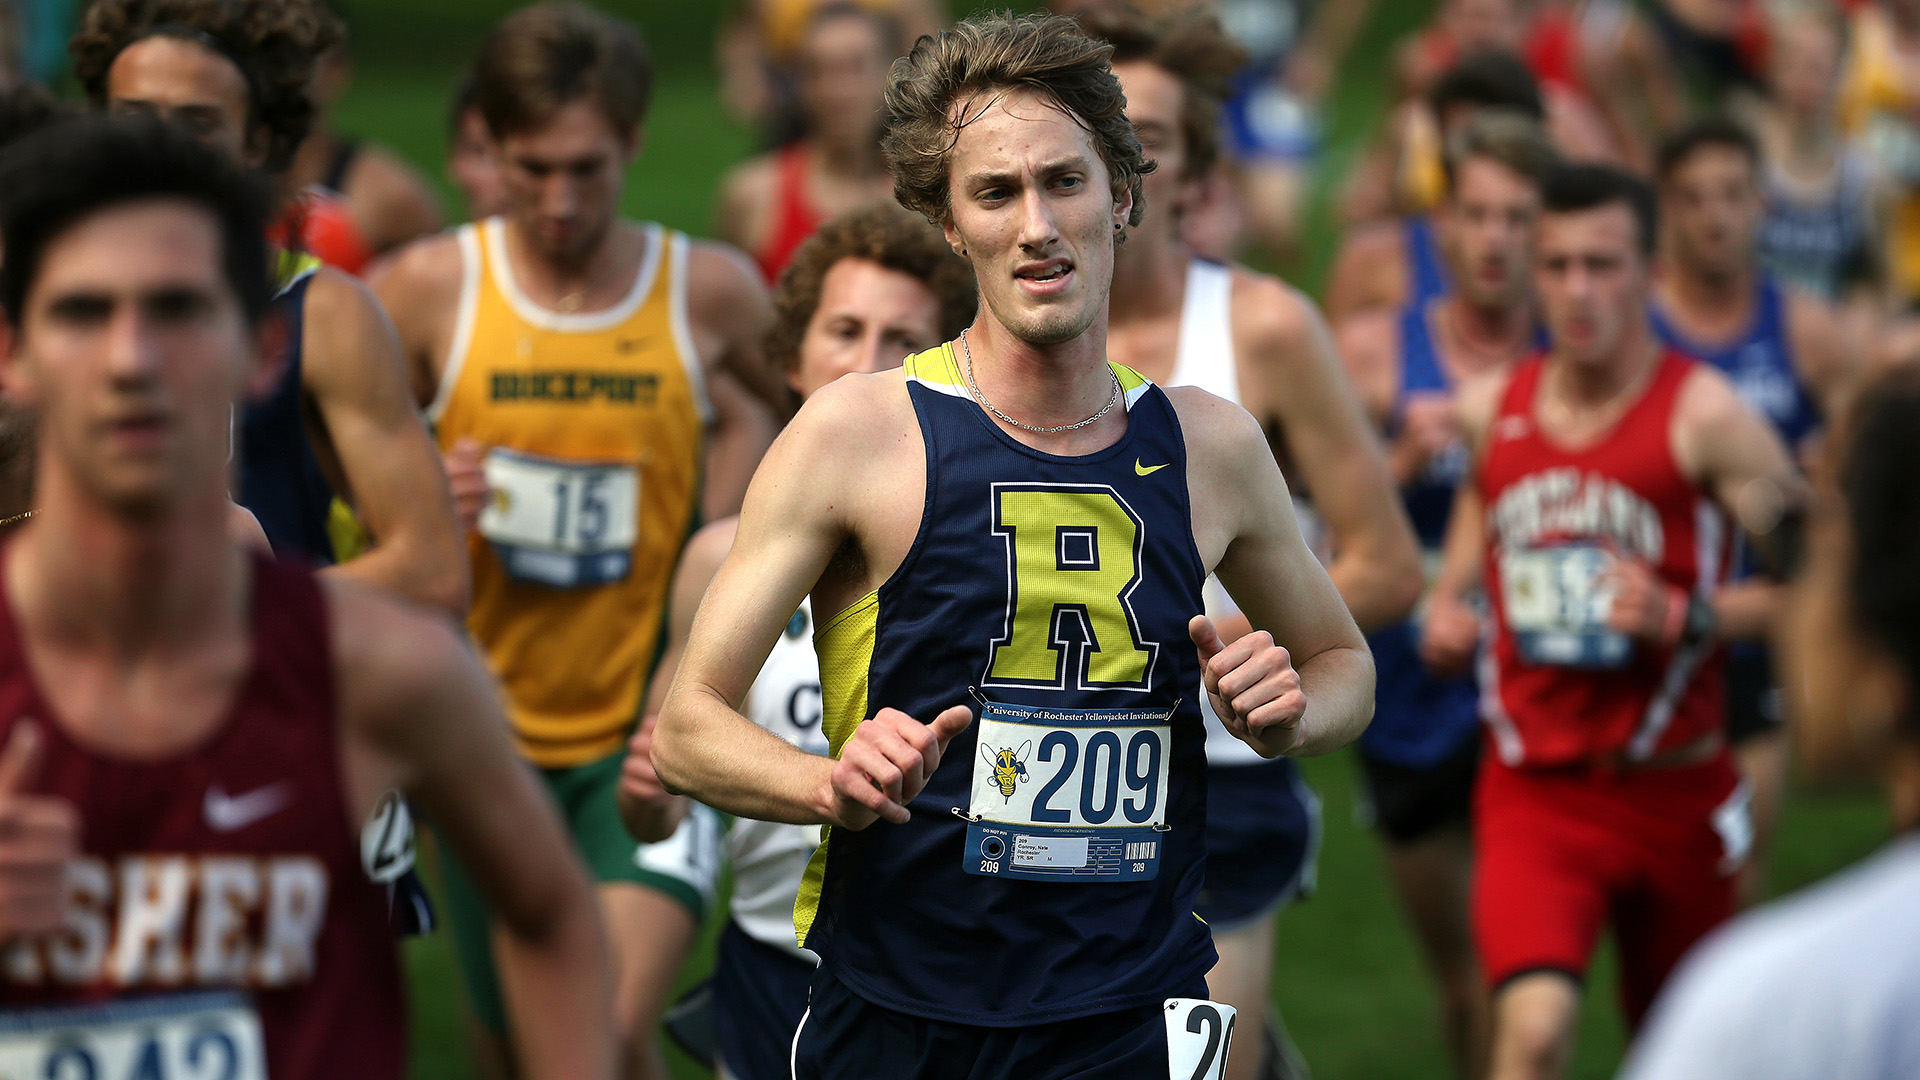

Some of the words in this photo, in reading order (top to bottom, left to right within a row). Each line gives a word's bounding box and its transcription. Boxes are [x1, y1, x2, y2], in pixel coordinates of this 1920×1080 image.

[552, 466, 612, 546] 15
[981, 482, 1160, 692] R
[987, 705, 1031, 719] University
[1033, 711, 1043, 719] of
[1085, 713, 1128, 722] Yellowjacket
[1130, 712, 1169, 720] Invitational
[1031, 730, 1161, 824] 209
[980, 860, 999, 874] 209
[1132, 862, 1145, 873] 209
[3, 853, 330, 987] SHER
